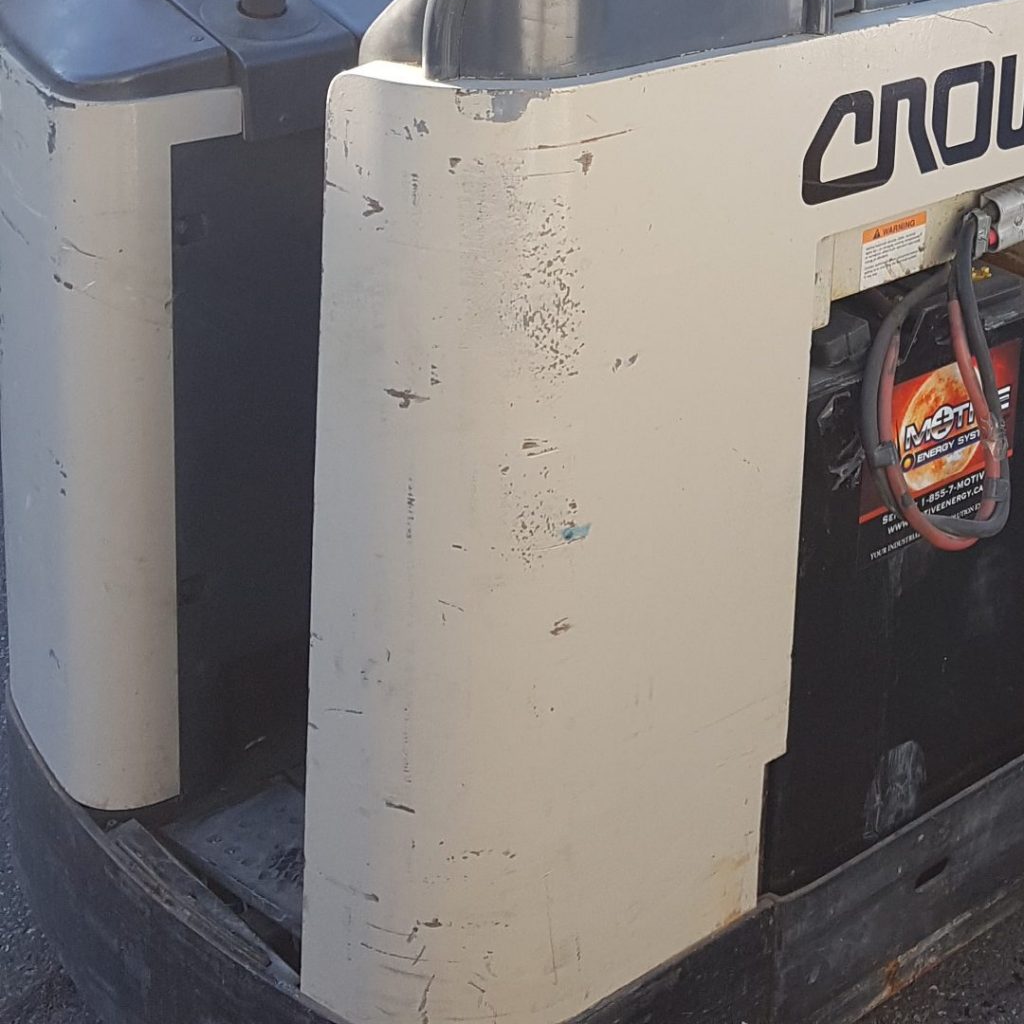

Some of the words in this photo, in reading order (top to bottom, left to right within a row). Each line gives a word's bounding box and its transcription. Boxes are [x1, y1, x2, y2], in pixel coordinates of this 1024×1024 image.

[903, 385, 1011, 452] MOTIE
[917, 440, 955, 464] ENERGY
[921, 470, 986, 507] 1-855-7-MOTIV
